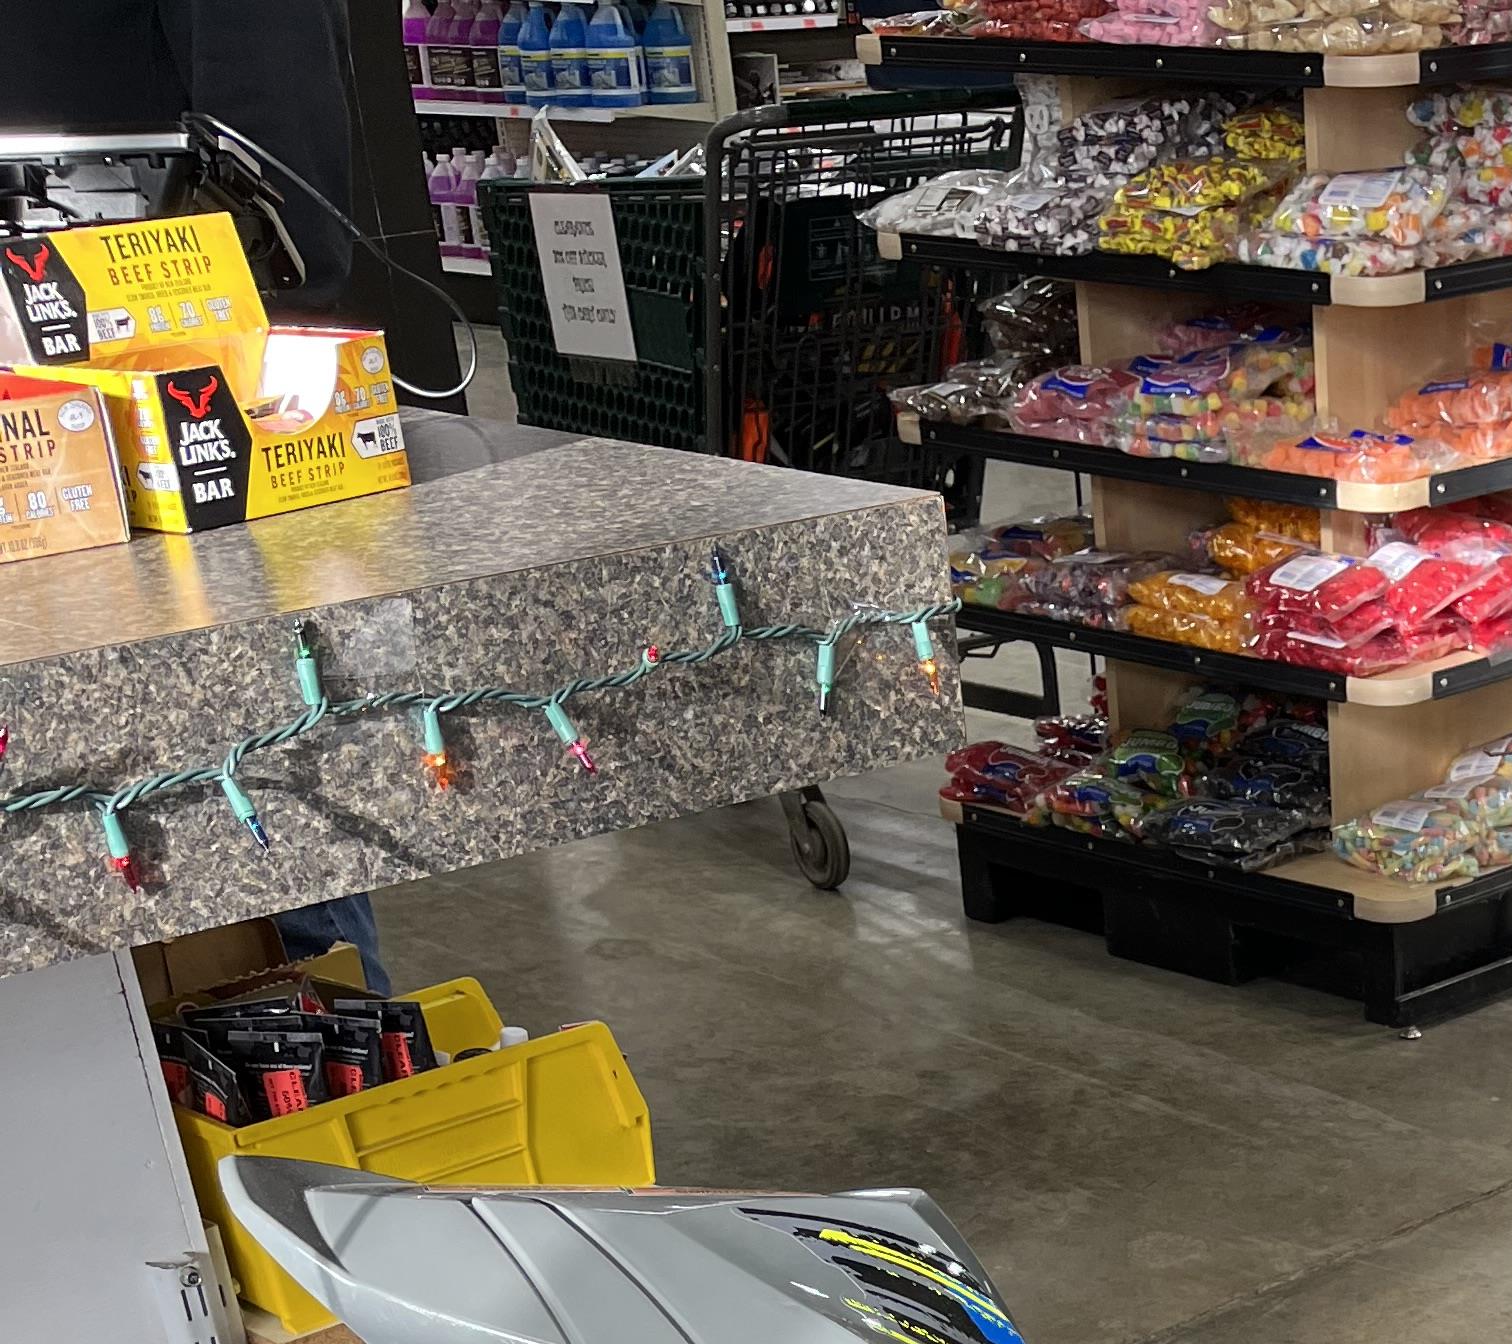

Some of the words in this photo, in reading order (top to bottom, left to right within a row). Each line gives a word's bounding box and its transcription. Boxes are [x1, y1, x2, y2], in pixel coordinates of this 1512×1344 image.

[100, 225, 202, 263] TERIYAKI
[107, 262, 153, 286] BEEF
[161, 256, 212, 279] STRIP
[23, 281, 59, 305] JACK
[42, 333, 81, 356] BAR
[180, 419, 224, 446] JACK
[380, 437, 398, 452] BEEF
[261, 432, 345, 472] TERIYAKI
[271, 472, 303, 489] BEEF
[309, 462, 345, 483] STRIP
[28, 492, 47, 509] 80
[61, 485, 92, 500] GLUTEN
[192, 479, 234, 503] BAR
[70, 499, 90, 512] FREE
